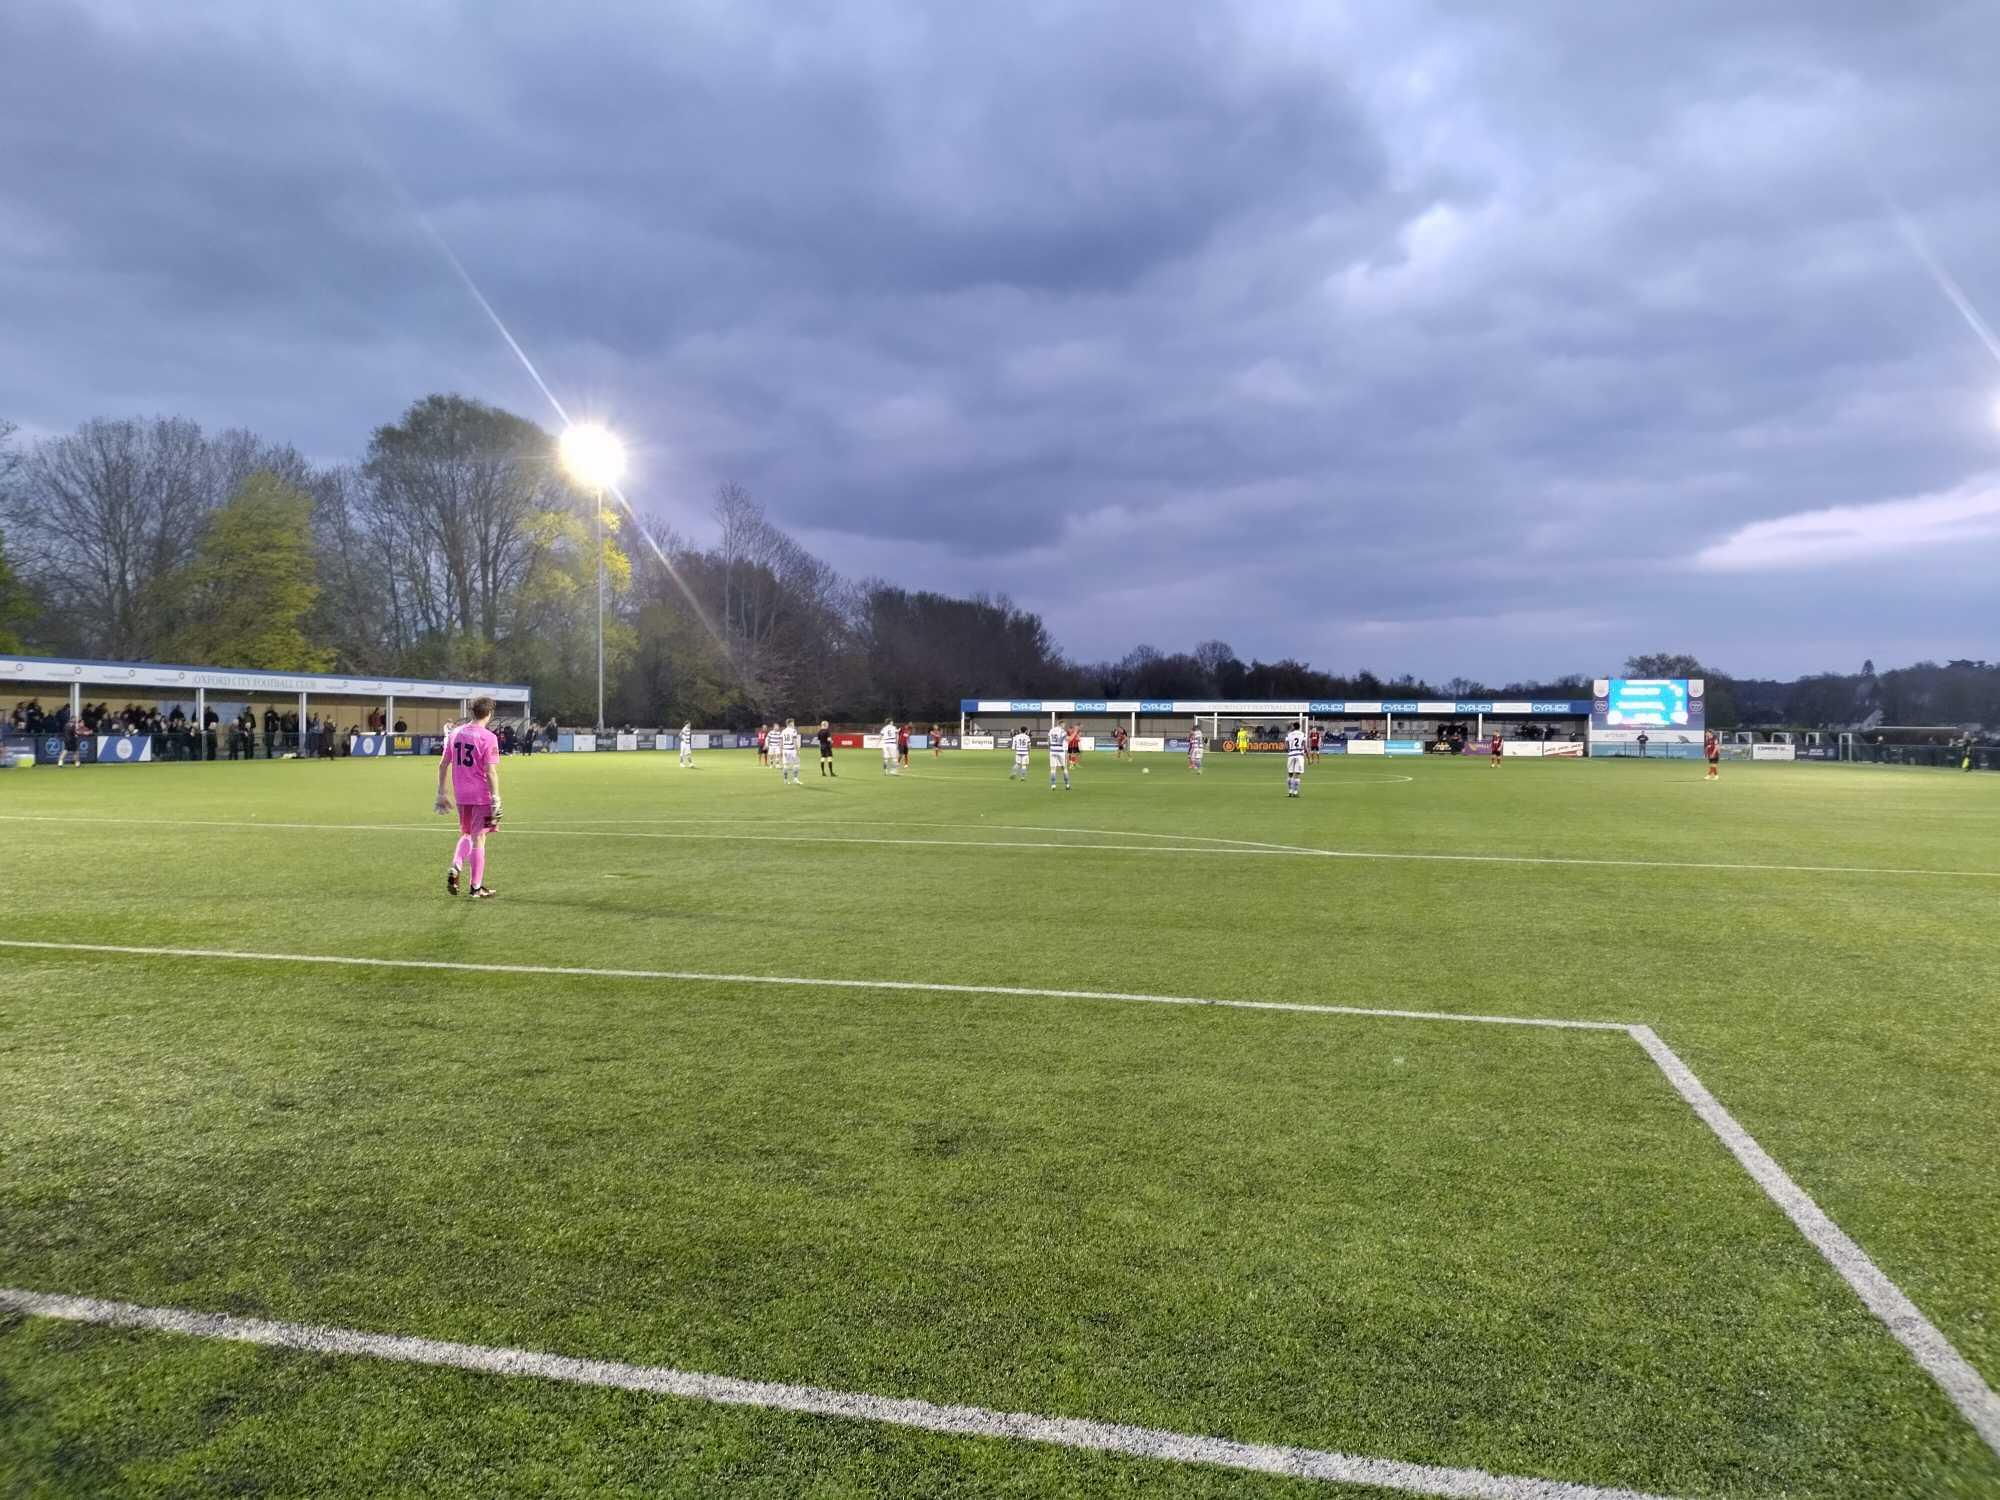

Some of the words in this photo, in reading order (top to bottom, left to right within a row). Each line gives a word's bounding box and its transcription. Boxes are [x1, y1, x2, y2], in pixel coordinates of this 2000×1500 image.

[231, 676, 252, 687] CITY
[254, 677, 294, 689] FOOTBALL
[1310, 703, 1344, 711] CYPHER
[1382, 703, 1417, 711] CYPHER
[1456, 703, 1492, 712] CYPHER
[1532, 703, 1569, 712] CYPHER
[454, 742, 475, 767] 13
